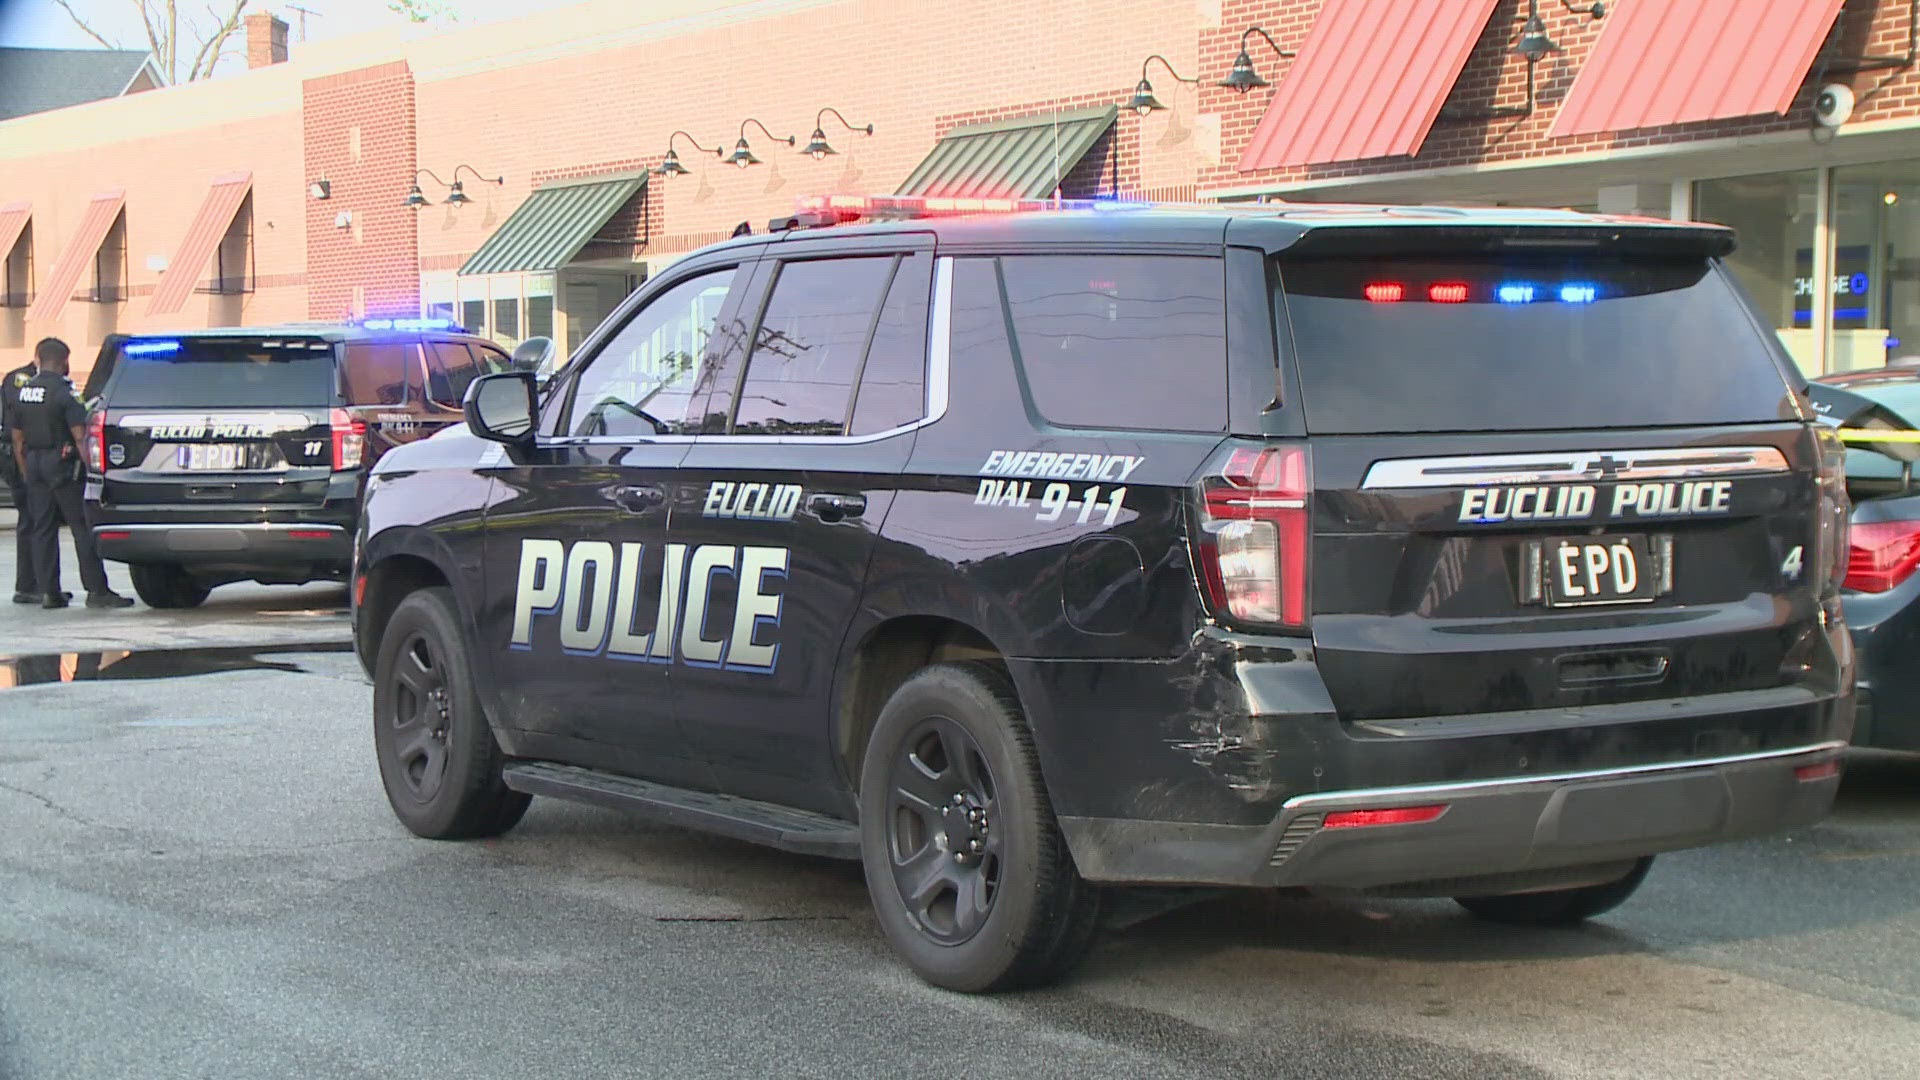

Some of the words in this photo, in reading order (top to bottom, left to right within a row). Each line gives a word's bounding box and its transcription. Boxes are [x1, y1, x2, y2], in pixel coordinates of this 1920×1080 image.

[1793, 275, 1850, 295] CHSE
[19, 386, 45, 402] POLICE
[150, 426, 206, 439] EUCLID
[303, 440, 323, 456] 11
[979, 450, 1145, 482] EMERGENCY
[702, 481, 803, 520] EUCLID
[973, 479, 1032, 507] DIAL
[1035, 482, 1127, 526] 9-1-1
[1458, 485, 1596, 523] EUCLID
[1611, 481, 1732, 518] POLICE
[1559, 544, 1637, 597] EPD
[1782, 545, 1803, 580] 4
[510, 538, 790, 674] POLICE
